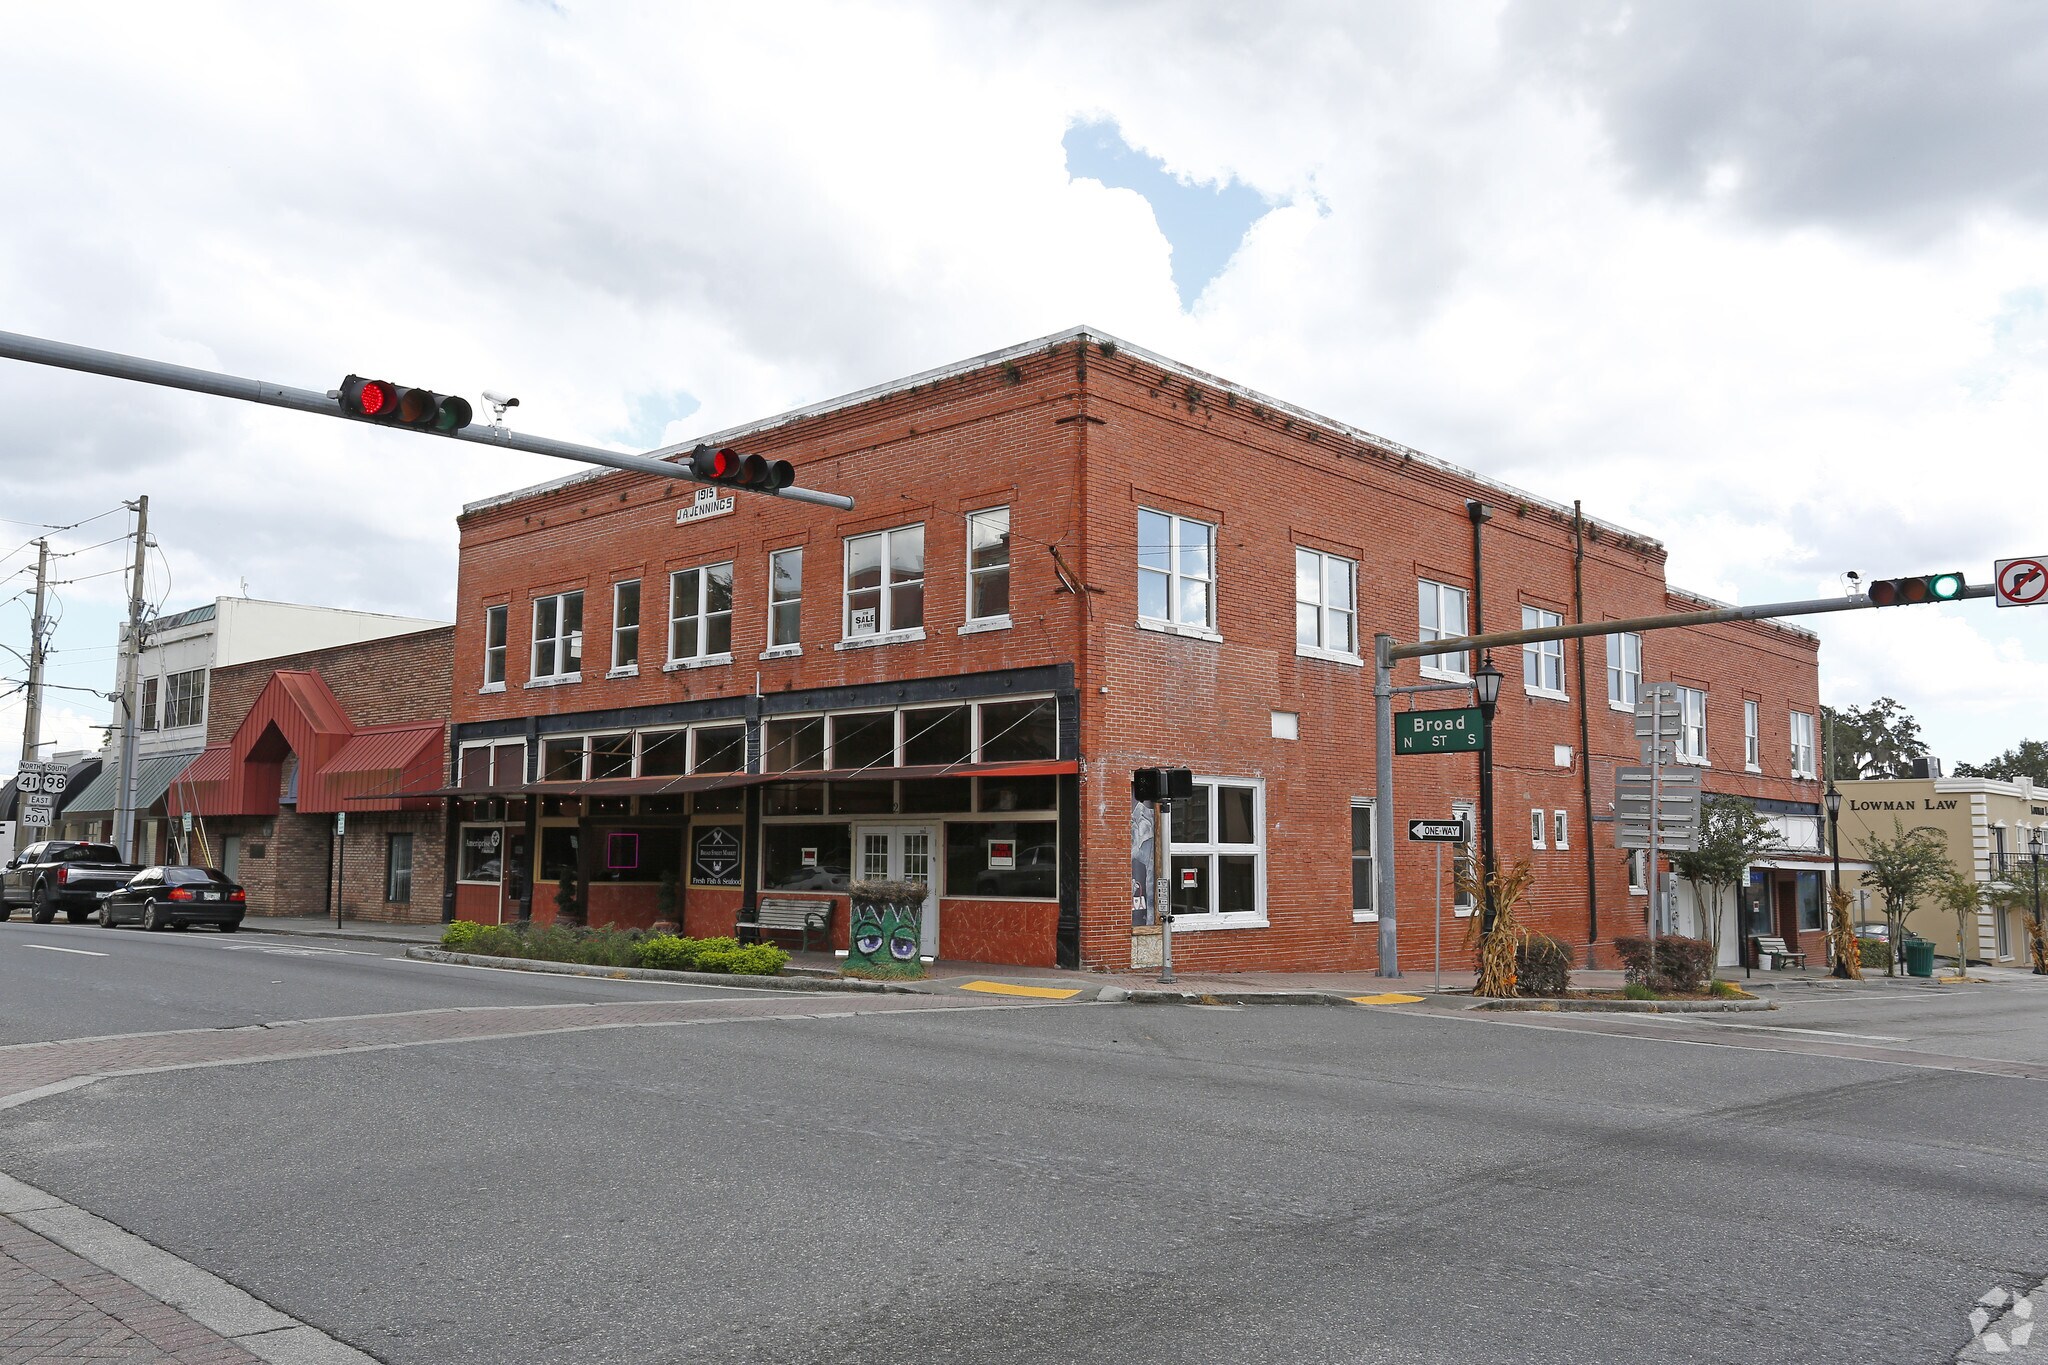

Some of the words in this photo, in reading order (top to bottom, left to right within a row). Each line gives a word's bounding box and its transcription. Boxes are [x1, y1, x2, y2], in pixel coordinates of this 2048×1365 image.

[698, 487, 714, 501] 1915
[690, 498, 732, 517] JENNINGS
[855, 614, 875, 624] SALE
[1413, 715, 1465, 732] Broad
[1404, 737, 1412, 748] N
[1432, 735, 1447, 746] ST
[1467, 733, 1476, 745] S
[20, 762, 41, 770] NORTH
[46, 764, 67, 772] SOUTH
[21, 776, 37, 788] 41
[46, 777, 65, 789] 98
[24, 814, 46, 823] 50A
[1424, 826, 1440, 835] ONE
[1441, 827, 1458, 835] WAY
